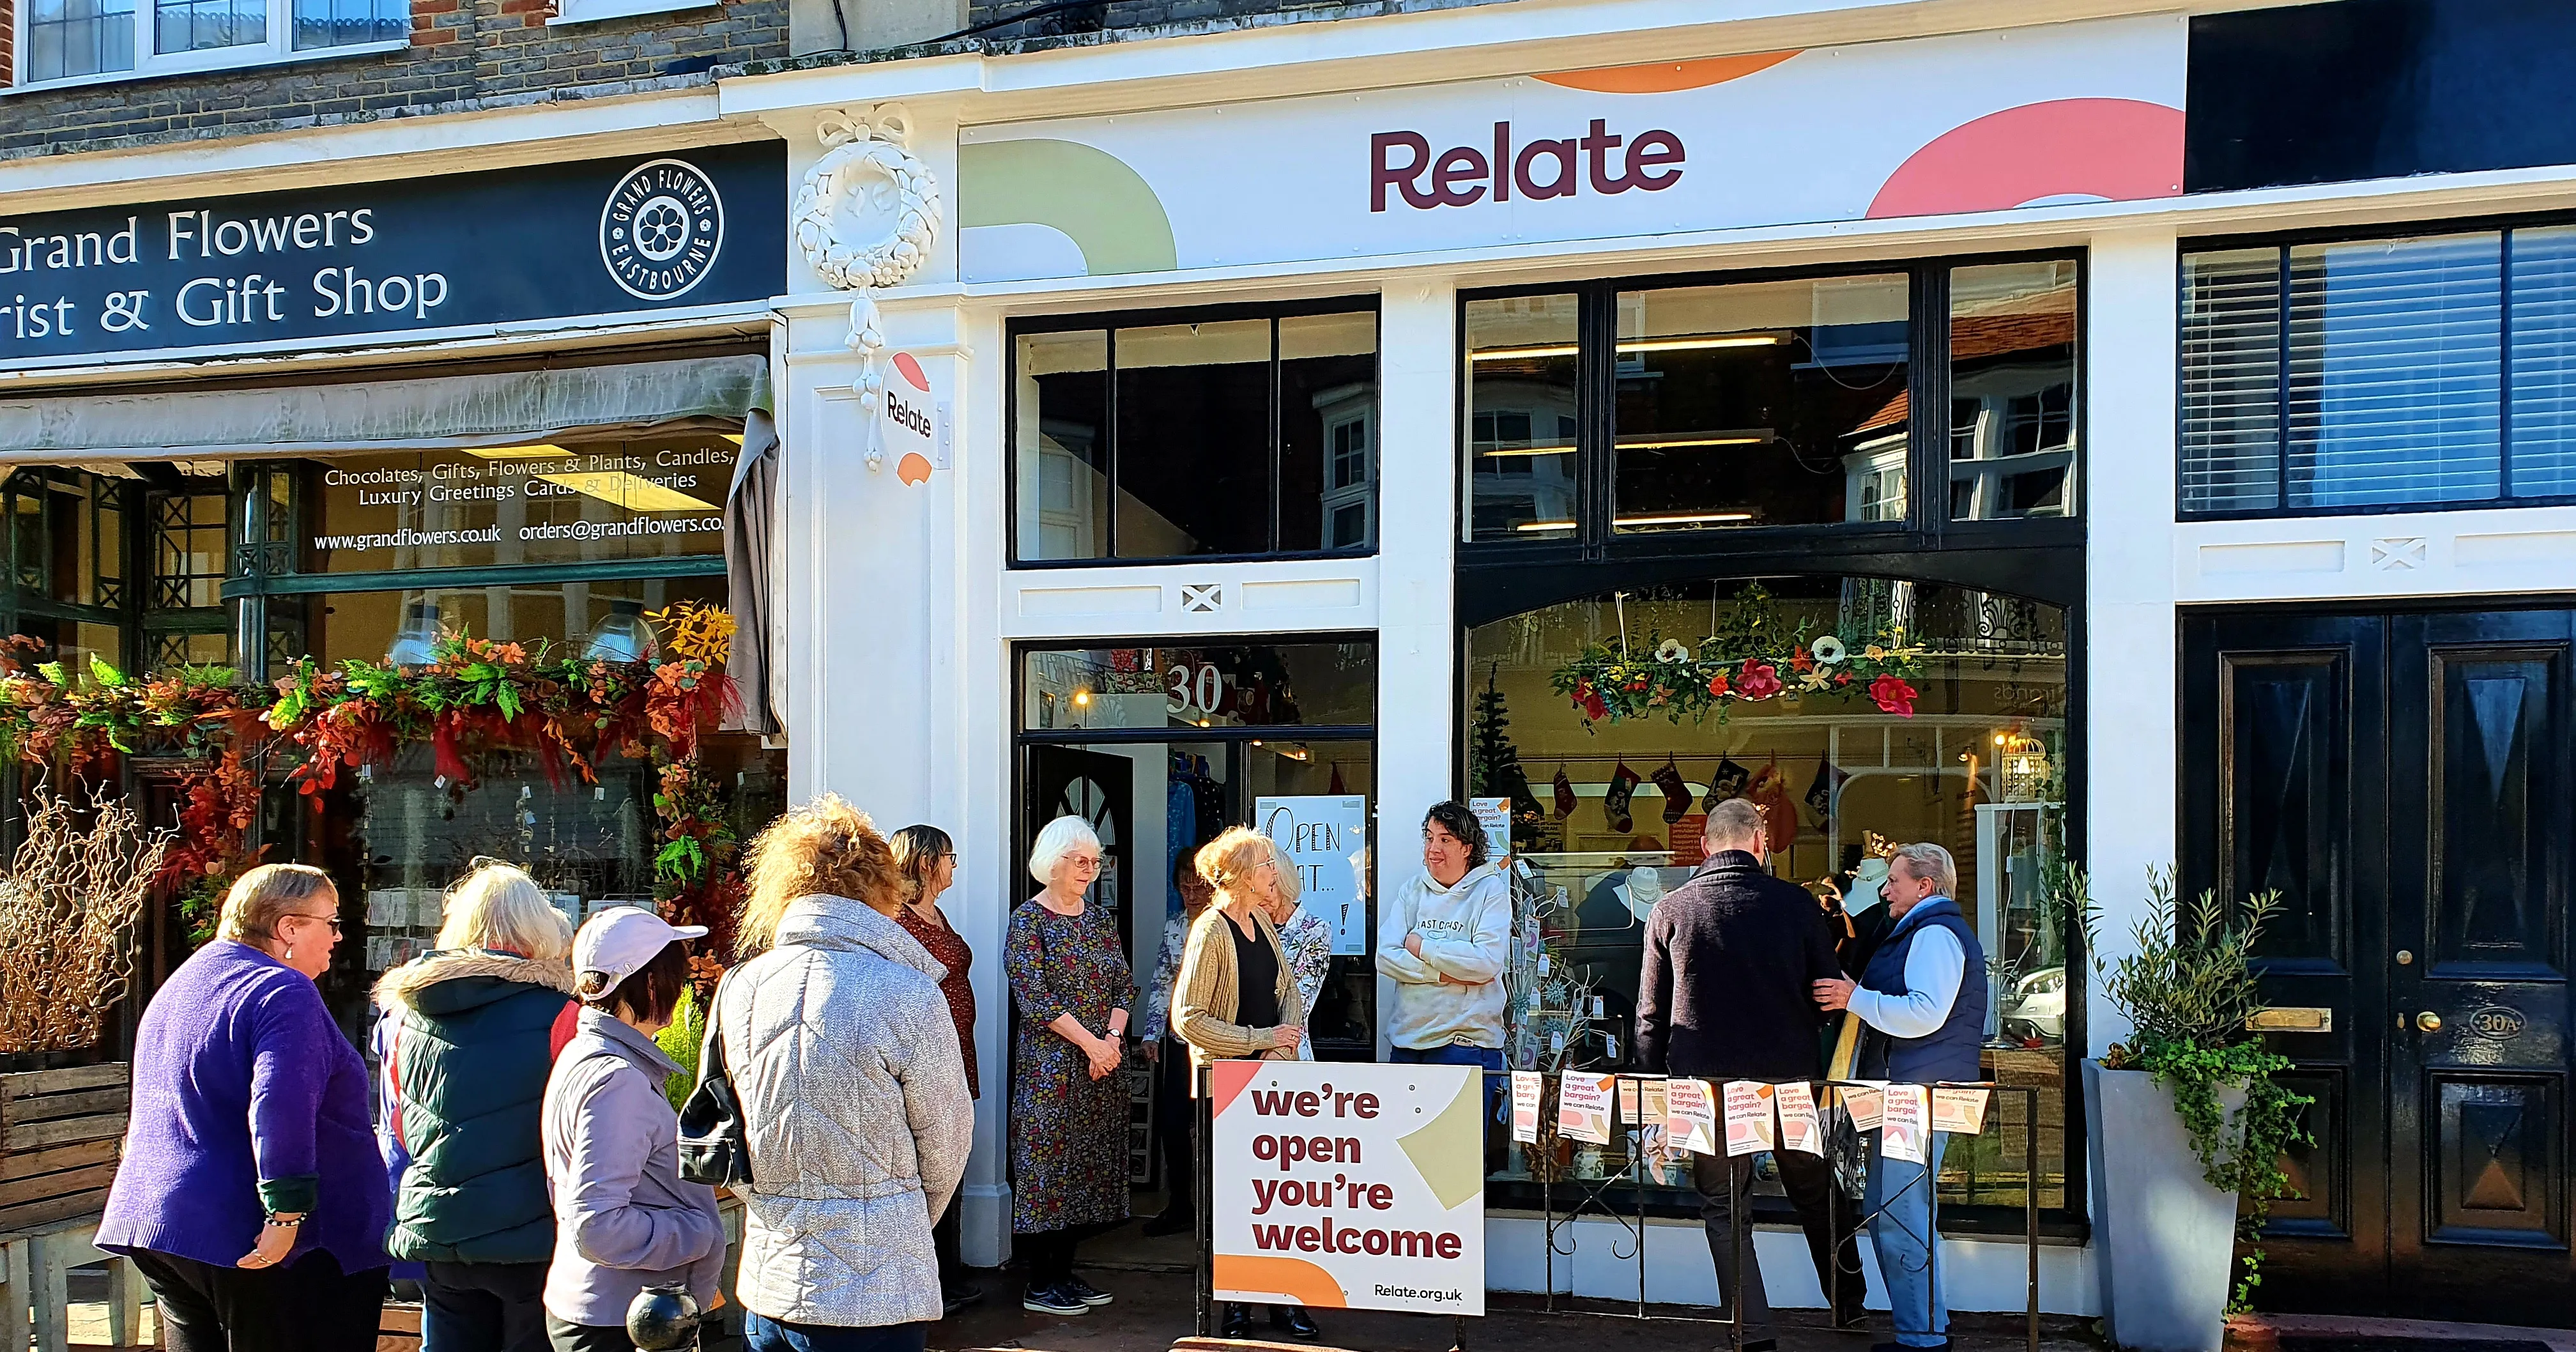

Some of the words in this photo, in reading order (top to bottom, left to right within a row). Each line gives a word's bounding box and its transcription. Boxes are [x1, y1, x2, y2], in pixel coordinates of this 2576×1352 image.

[1371, 118, 1685, 213] Relate
[613, 175, 650, 221] GRAND
[659, 170, 711, 215] FLOWERS
[168, 209, 374, 259] Flowers
[612, 238, 710, 289] EASTBOURNE
[100, 289, 150, 332] &
[176, 274, 286, 326] Gift
[314, 266, 447, 319] Shop
[887, 390, 931, 438] Relate
[325, 467, 423, 486] Chocolates,
[432, 463, 480, 480] Gifts,
[489, 460, 555, 476] Flowers
[564, 458, 581, 472] &
[589, 454, 647, 470] Plants,
[656, 449, 734, 467] Candles,
[360, 489, 422, 505] Luxury
[429, 484, 514, 502] Greetings
[524, 480, 576, 496] Cards
[585, 479, 601, 493] &
[610, 474, 696, 492] Deliveries
[314, 524, 502, 551] www.grandflowers.co.uk
[519, 516, 724, 541] orders@grandflowers.co.
[1166, 664, 1223, 714] 30
[1265, 806, 1340, 853] OPEN
[2479, 1014, 2518, 1031] 30A
[1251, 1083, 1380, 1119] we're
[1564, 1090, 1600, 1101] bargain?
[1671, 1098, 1706, 1109] bargain?
[1728, 1101, 1761, 1111] bargain?
[1733, 1093, 1754, 1103] great
[1693, 1111, 1710, 1119] Relate
[1252, 1133, 1361, 1171] open
[1251, 1173, 1393, 1215] you're
[1251, 1217, 1462, 1259] welcome
[1374, 1284, 1463, 1302] Relate.org.uk
